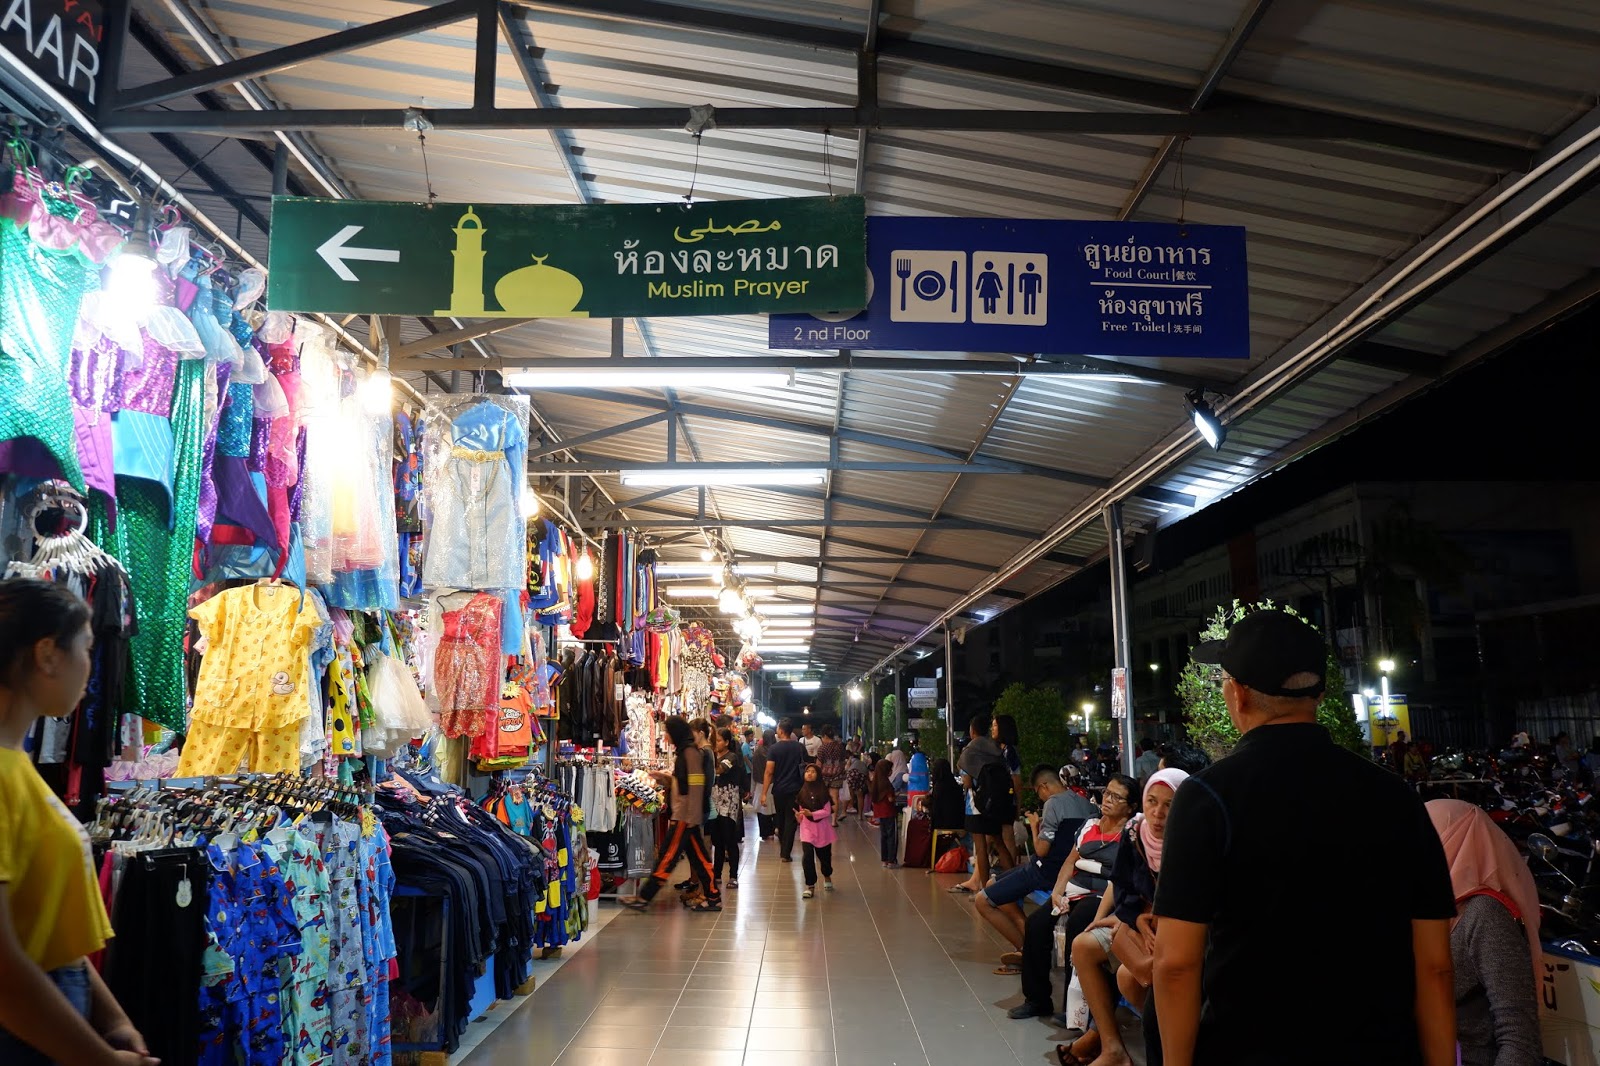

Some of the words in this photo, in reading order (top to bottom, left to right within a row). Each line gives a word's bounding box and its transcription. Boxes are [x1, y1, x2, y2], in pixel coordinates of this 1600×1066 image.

[613, 239, 839, 275] ห้องละหมาด
[1083, 235, 1211, 270] ศูนย์อาหาร
[1104, 267, 1132, 279] Food
[647, 281, 724, 299] Muslim
[734, 279, 809, 299] Prayer
[1098, 290, 1203, 321] ห้องสุขาฟรี
[794, 327, 803, 340] 2
[808, 327, 828, 340] nd
[834, 326, 871, 340] Floor
[1102, 321, 1128, 332] Free
